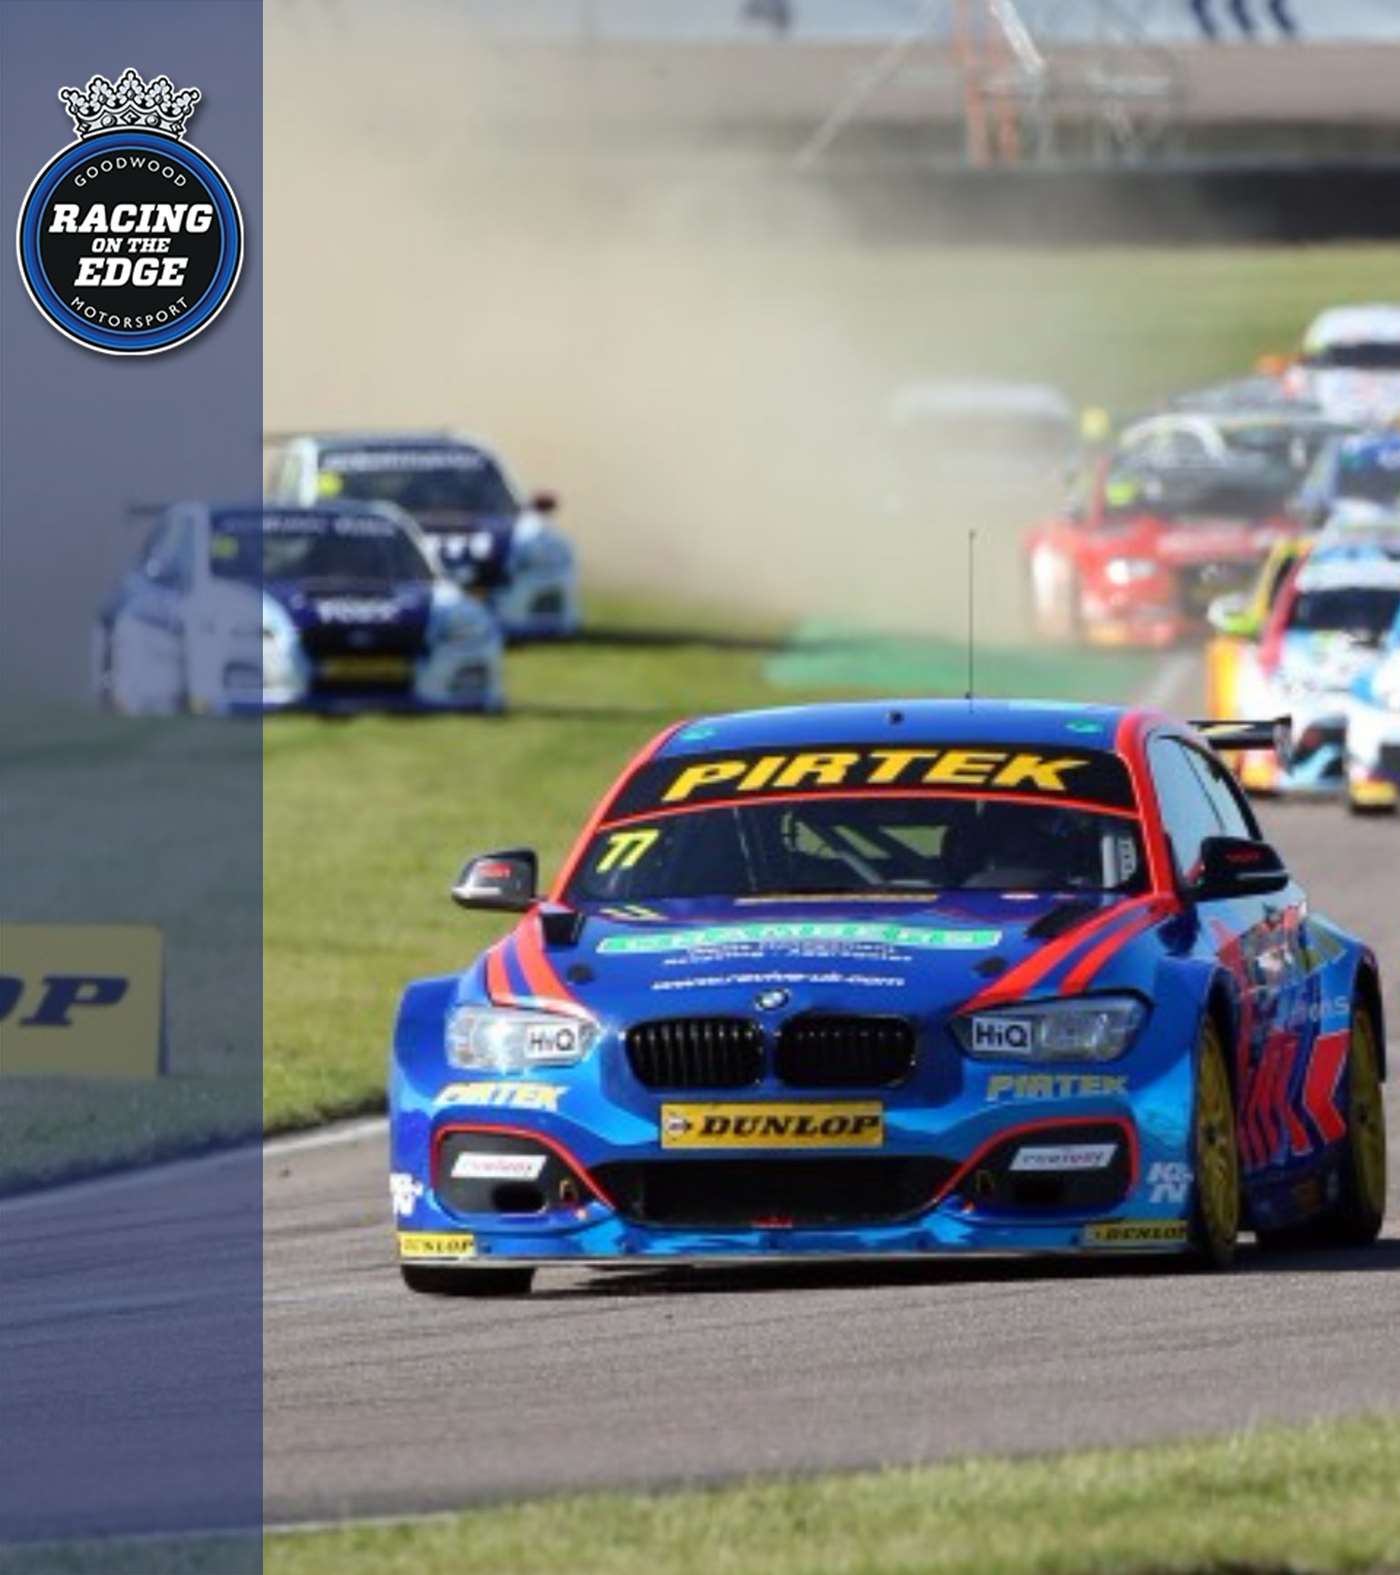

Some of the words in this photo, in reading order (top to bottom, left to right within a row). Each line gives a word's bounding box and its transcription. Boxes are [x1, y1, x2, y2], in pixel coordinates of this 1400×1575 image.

[662, 750, 1094, 802] PIRTEK
[596, 828, 660, 872] 77
[529, 1028, 576, 1052] HiQ
[975, 1023, 1029, 1049] HiQ
[433, 1081, 571, 1111] PIRTEK
[987, 1074, 1130, 1102] PIRTEK
[699, 1114, 881, 1137] DUNLOP
